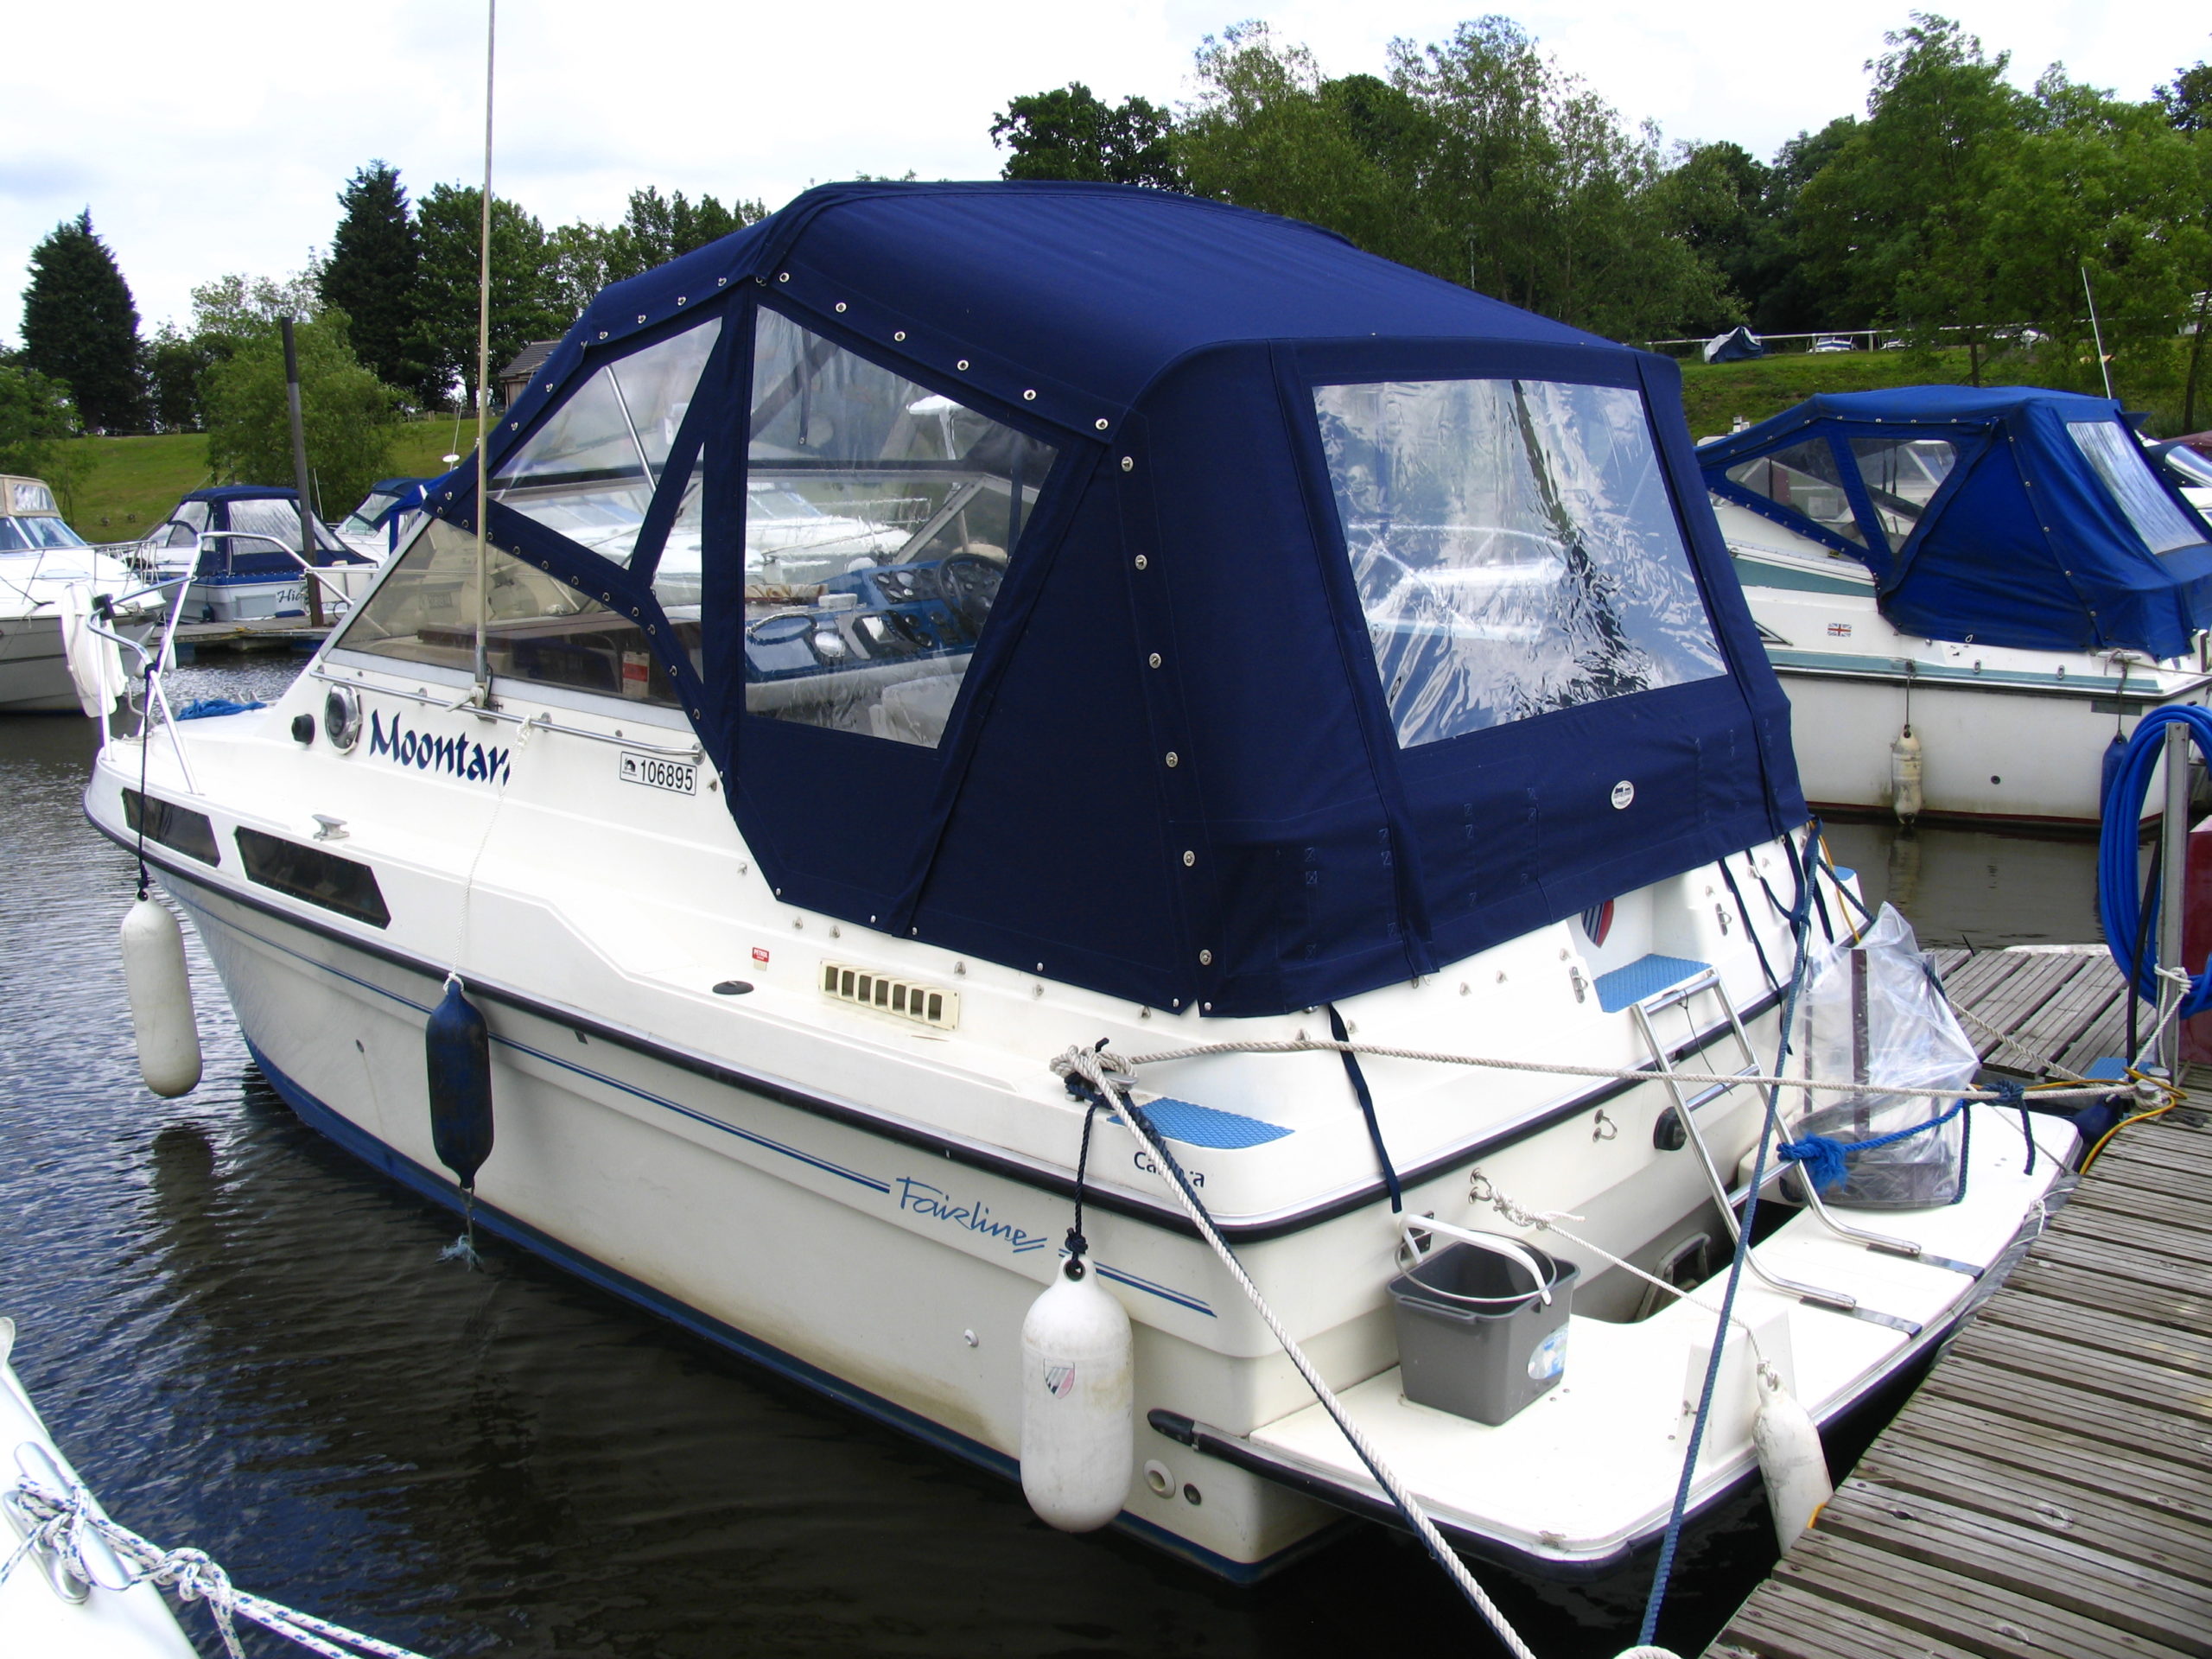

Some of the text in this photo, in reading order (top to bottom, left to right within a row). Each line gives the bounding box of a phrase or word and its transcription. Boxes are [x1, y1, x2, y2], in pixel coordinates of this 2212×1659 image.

[369, 709, 511, 787] Moontan
[640, 760, 693, 791] 106895
[896, 1176, 1047, 1253] Fairline
